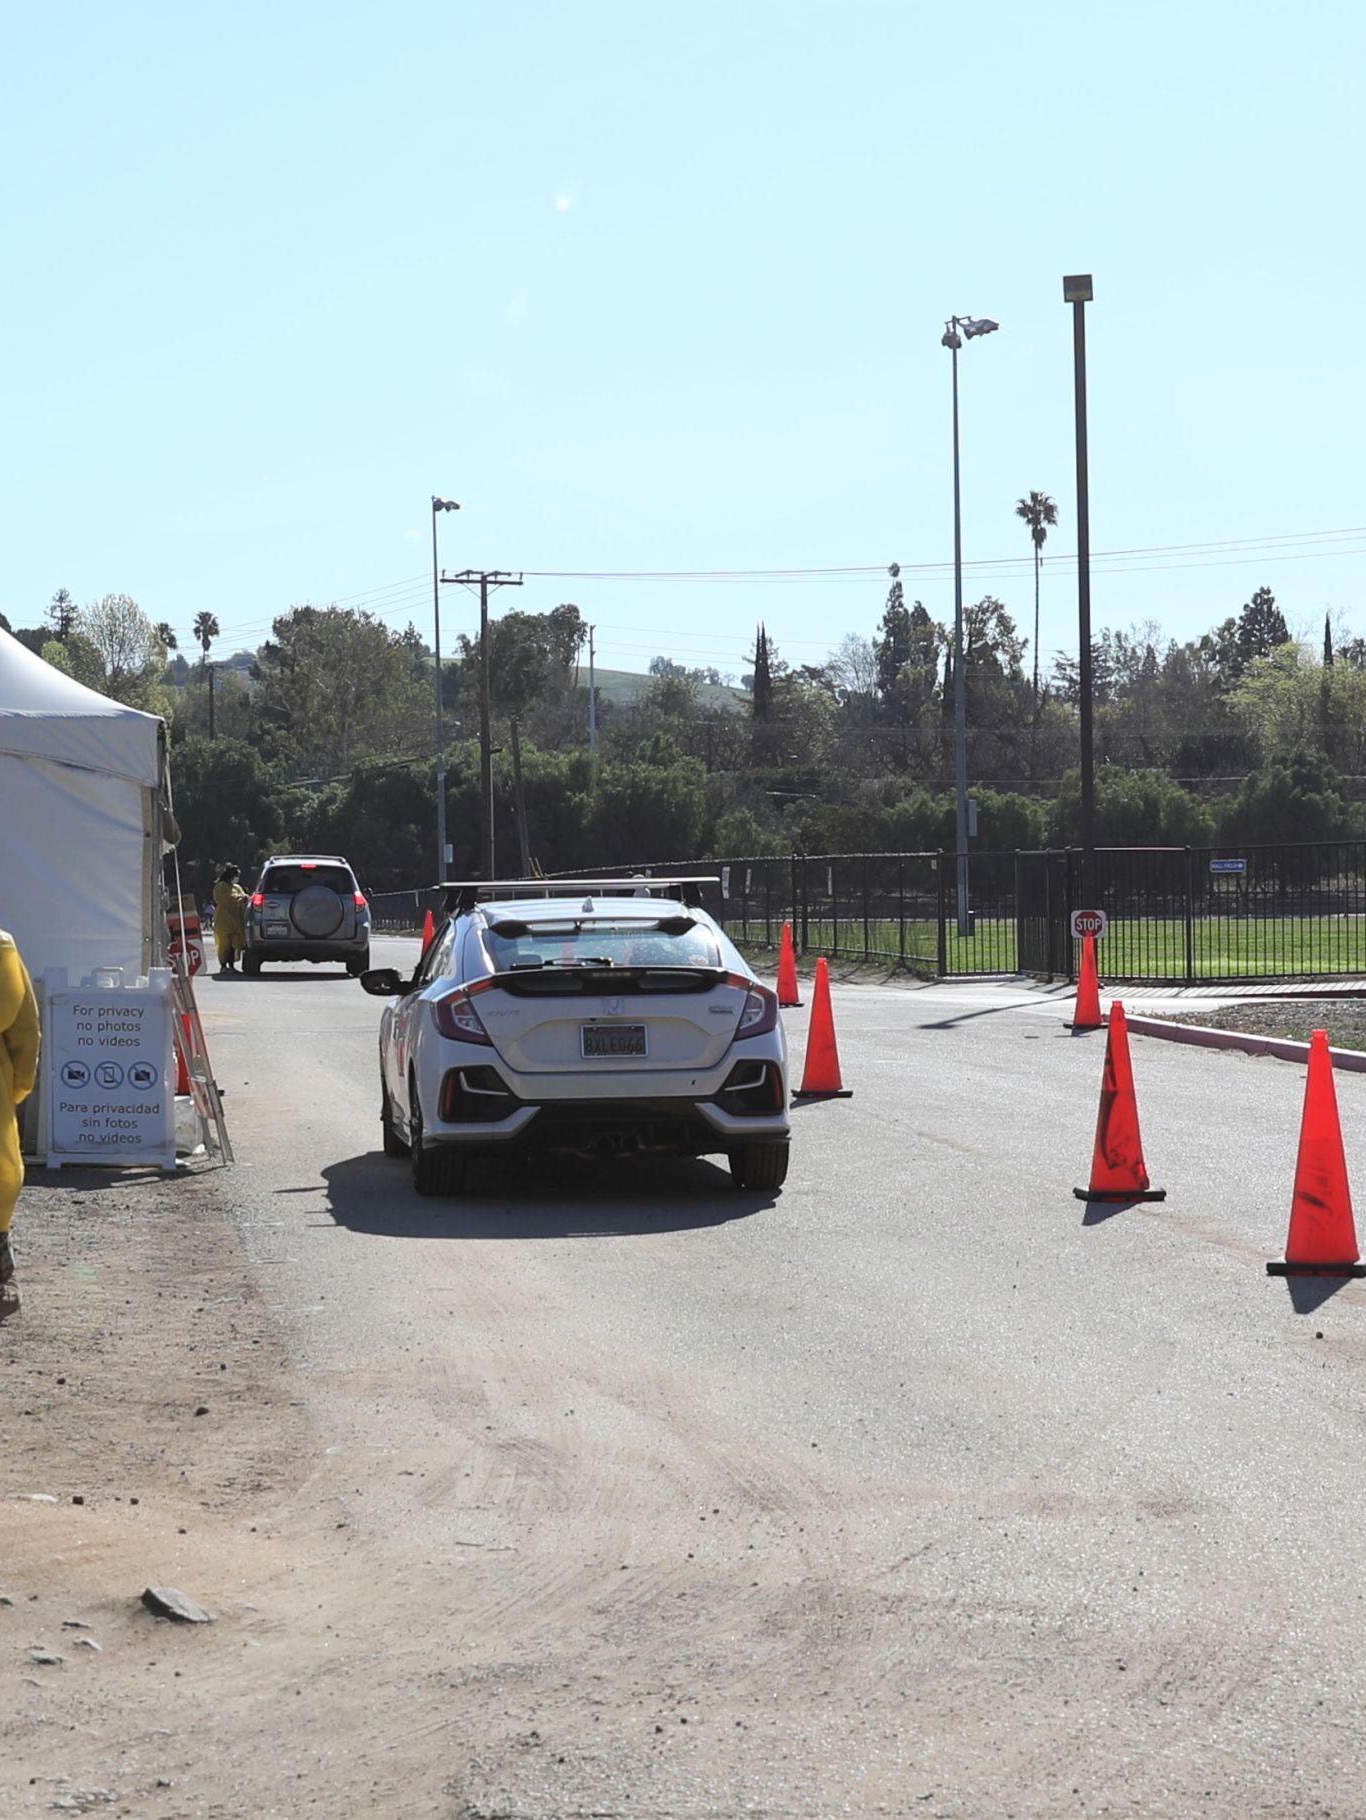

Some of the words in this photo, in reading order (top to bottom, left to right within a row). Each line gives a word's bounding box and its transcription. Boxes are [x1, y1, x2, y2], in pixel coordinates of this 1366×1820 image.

[1076, 918, 1101, 930] STOP
[72, 1005, 93, 1016] For
[98, 1005, 145, 1018] privacy
[76, 1022, 93, 1031] no
[97, 1021, 141, 1033] photos
[78, 1037, 94, 1046] no
[98, 1035, 141, 1046] videos
[59, 1102, 88, 1113] Para
[92, 1103, 160, 1115] privacidad
[82, 1118, 100, 1128] sin
[105, 1118, 138, 1129] fotos
[79, 1133, 95, 1143] no
[99, 1133, 142, 1144] videos
